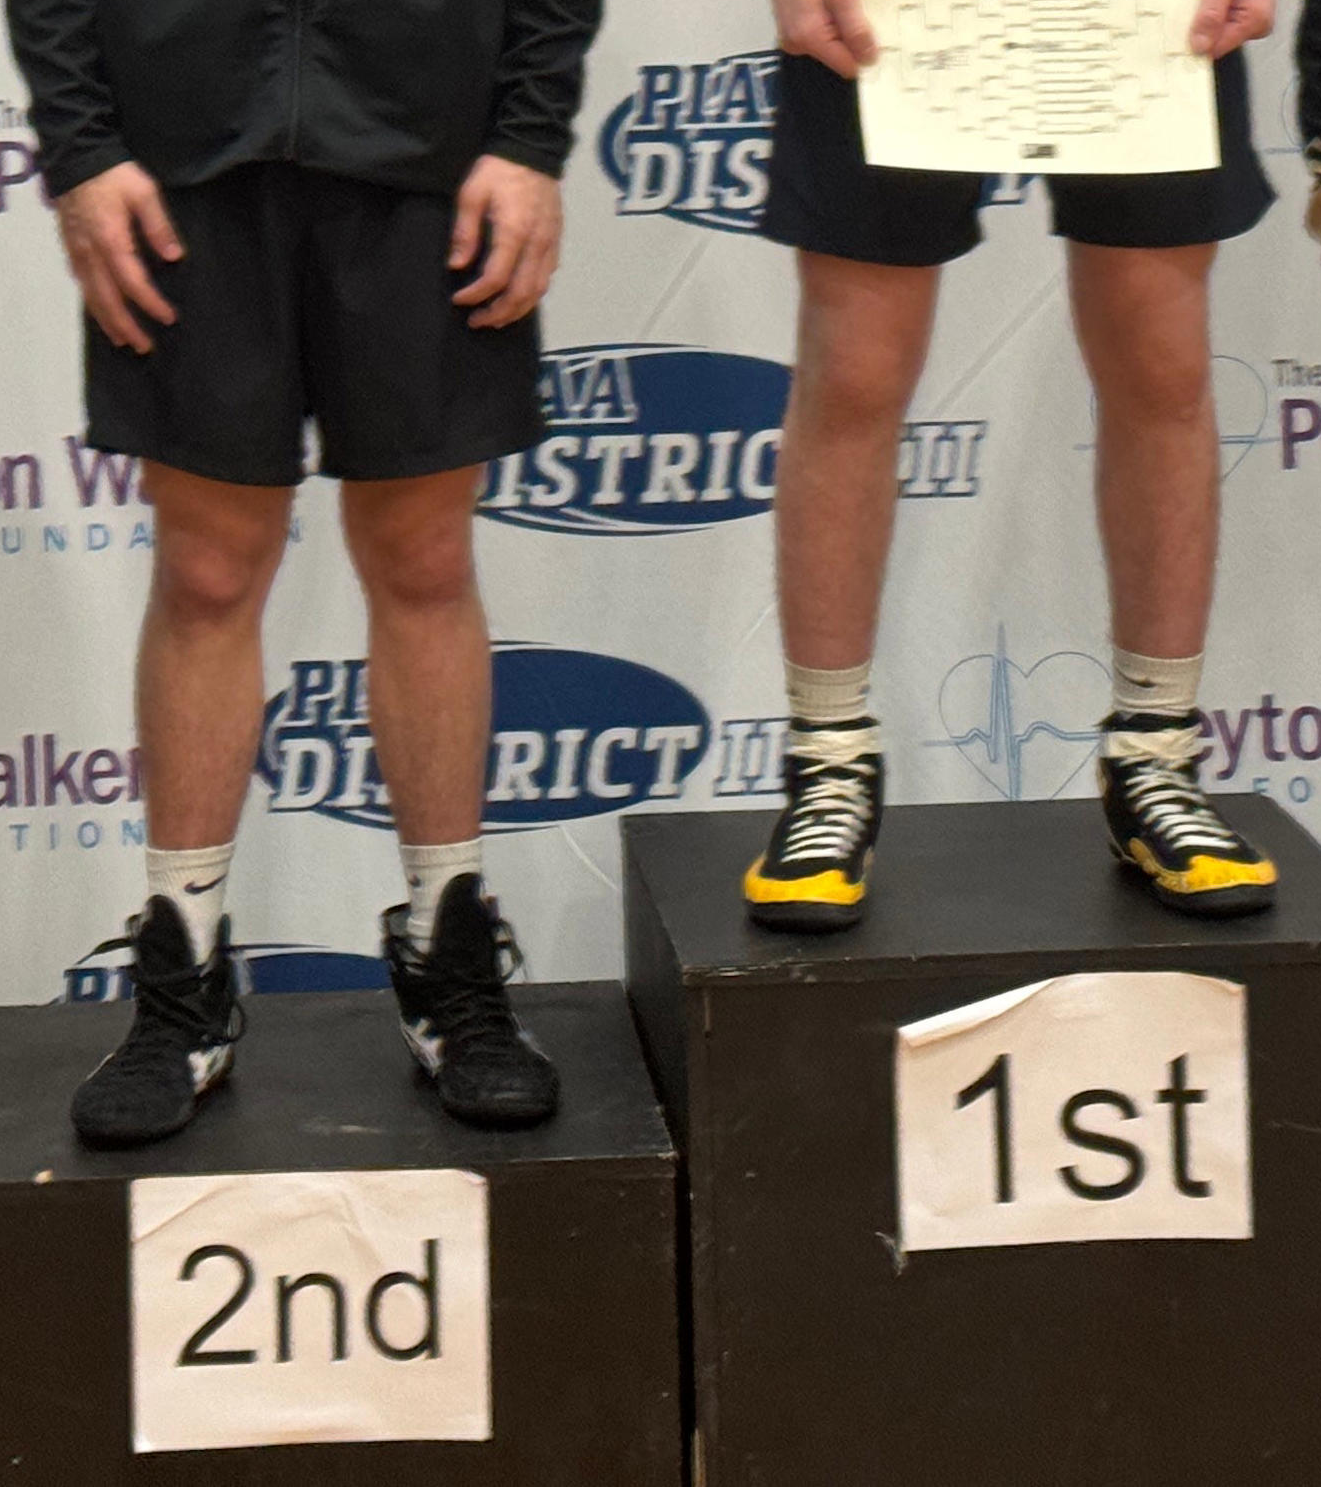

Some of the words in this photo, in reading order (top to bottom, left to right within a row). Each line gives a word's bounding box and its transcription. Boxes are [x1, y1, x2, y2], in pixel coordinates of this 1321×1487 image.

[478, 429, 785, 509] ISTRIC
[954, 1052, 1212, 1204] 1st
[176, 1238, 442, 1368] 2nd
